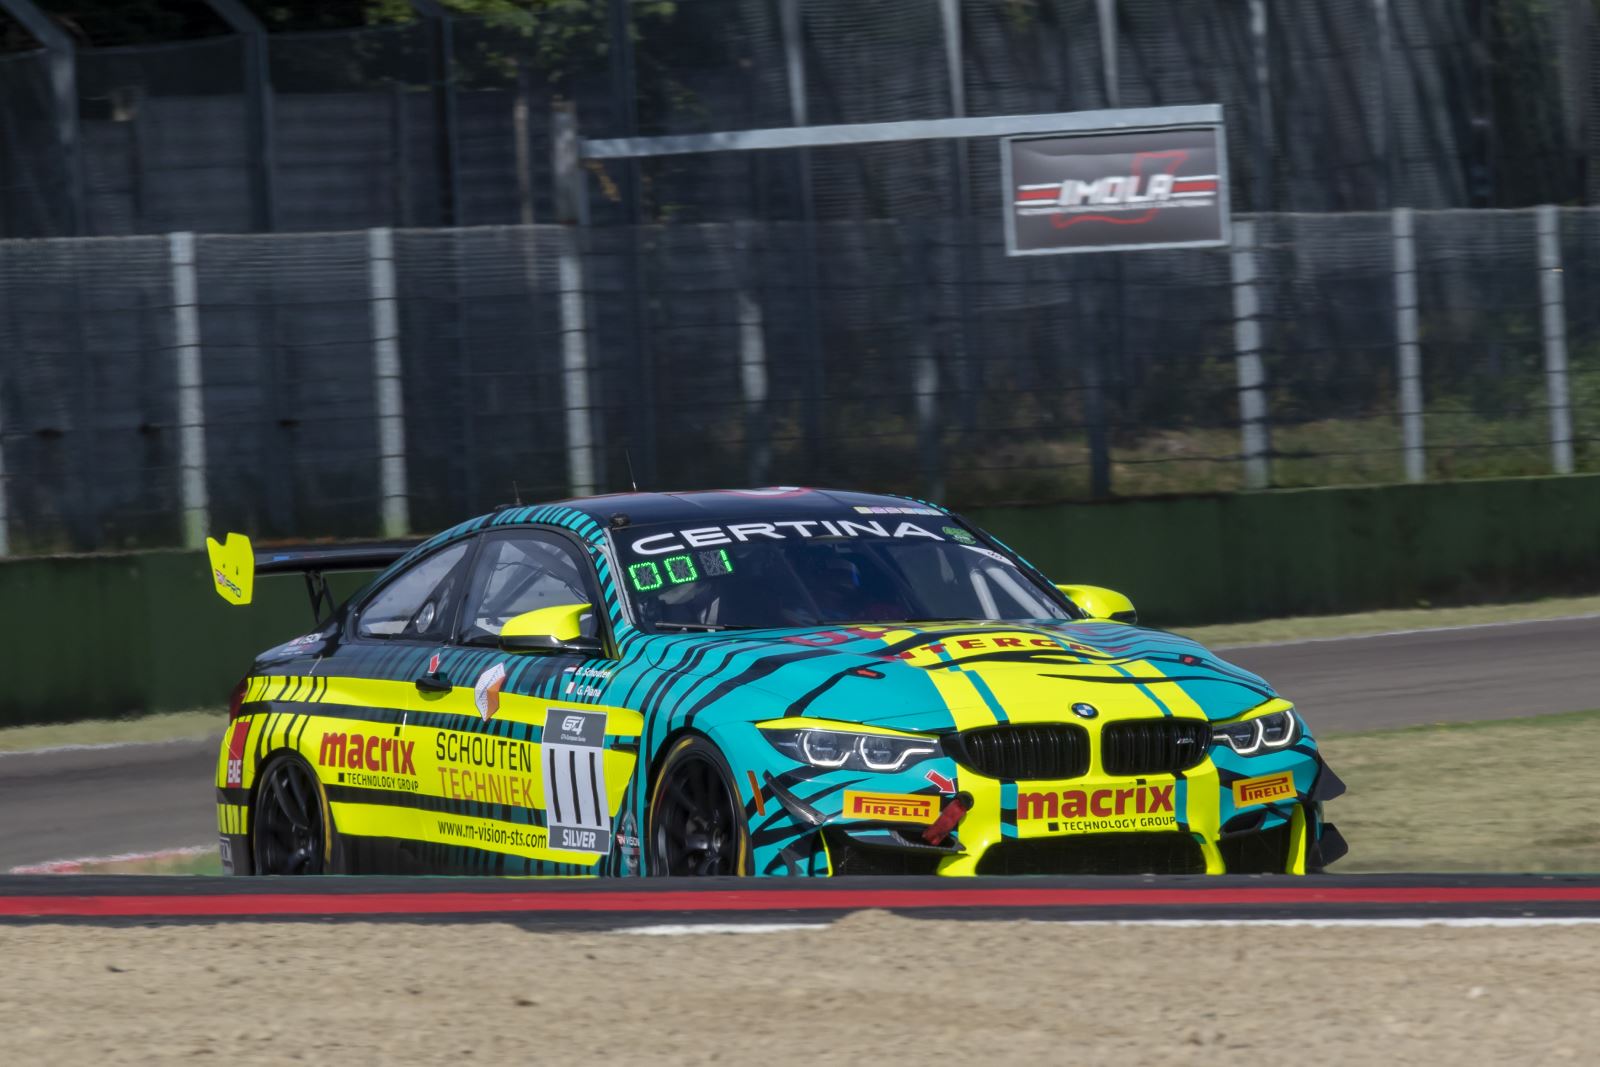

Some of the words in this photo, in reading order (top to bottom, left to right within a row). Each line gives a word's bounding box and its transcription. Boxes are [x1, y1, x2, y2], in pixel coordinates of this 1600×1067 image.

[1057, 174, 1175, 206] IMOLA
[631, 520, 946, 556] CERTINA
[628, 548, 734, 591] 001
[561, 715, 586, 735] GT4
[319, 726, 417, 776] macrix
[436, 731, 532, 773] SCHOUTEN
[347, 772, 396, 789] TECHNOLOGY
[397, 777, 419, 792] GROUP
[438, 766, 536, 810] TECHNIEK
[549, 748, 603, 827] 111
[1240, 776, 1291, 802] PIRELLI
[853, 796, 932, 818] PIRELLI
[1017, 778, 1175, 820] macrix
[438, 820, 548, 849] www.rn-vision-sts.com
[562, 828, 597, 849] SILVER
[1062, 817, 1137, 832] TECHNOLOGY
[1140, 816, 1177, 828] GROUP
